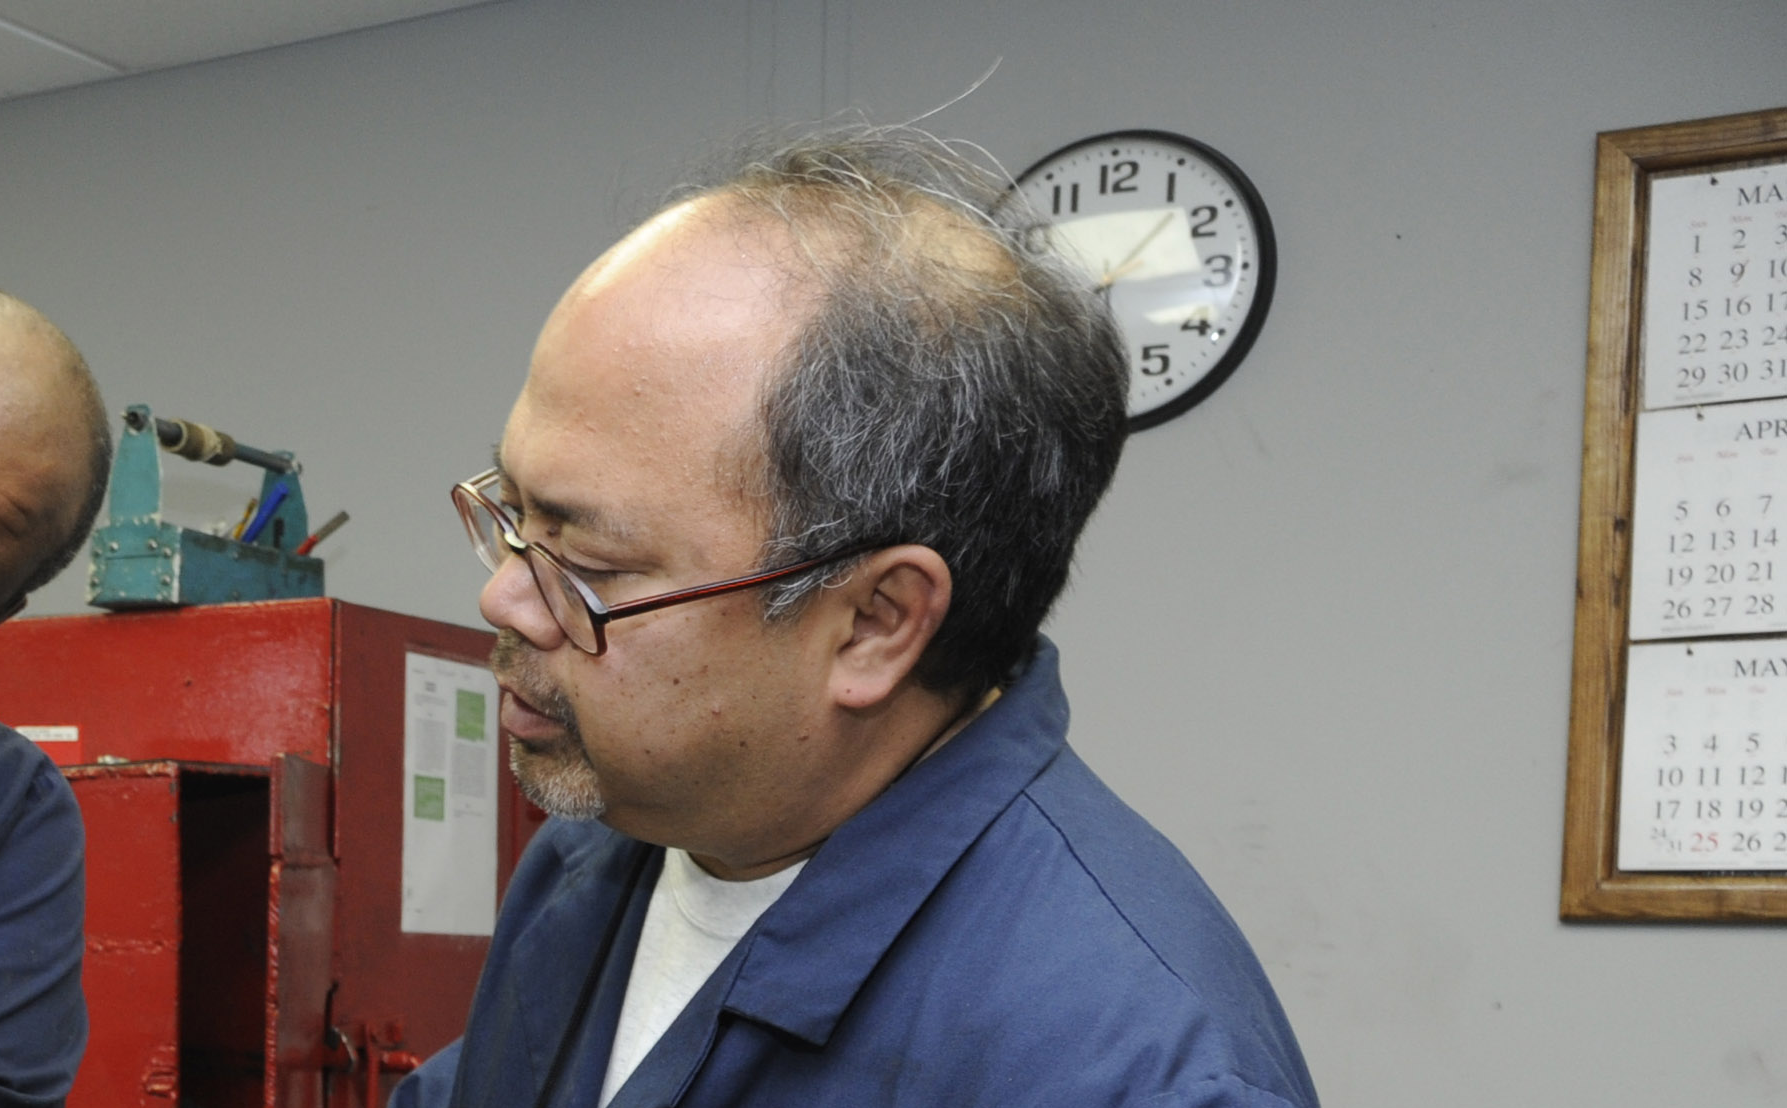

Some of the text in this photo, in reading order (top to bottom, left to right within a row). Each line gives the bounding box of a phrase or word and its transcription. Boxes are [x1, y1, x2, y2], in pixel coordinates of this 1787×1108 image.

[1098, 161, 1140, 195] 12
[1166, 172, 1177, 203] 1
[1051, 183, 1080, 215] 11
[1190, 205, 1219, 238] 2
[1694, 224, 1787, 253] 1 2 3
[1203, 254, 1233, 288] 3
[1688, 268, 1703, 287] 8
[1729, 263, 1746, 281] 9
[1181, 306, 1211, 336] 4
[1683, 300, 1709, 321] 15
[1725, 297, 1752, 316] 16
[1678, 333, 1707, 355] 22
[1719, 328, 1749, 350] 23
[1140, 344, 1171, 376] 5
[1676, 359, 1787, 388] 29 30 31
[1675, 494, 1774, 520] 5 6 7
[1669, 528, 1779, 553] 12 13 14
[1667, 561, 1773, 586] 19 20 21
[1662, 594, 1775, 619] 26 27 28
[1663, 733, 1760, 754] 3 4 5
[1657, 768, 1684, 786] 10
[1698, 767, 1721, 786] 11
[1740, 765, 1766, 785] 12
[1655, 800, 1681, 819] 17
[1696, 800, 1722, 819] 18
[1737, 800, 1765, 818] 19
[1689, 832, 1719, 852] 25
[1731, 832, 1762, 851] 26
